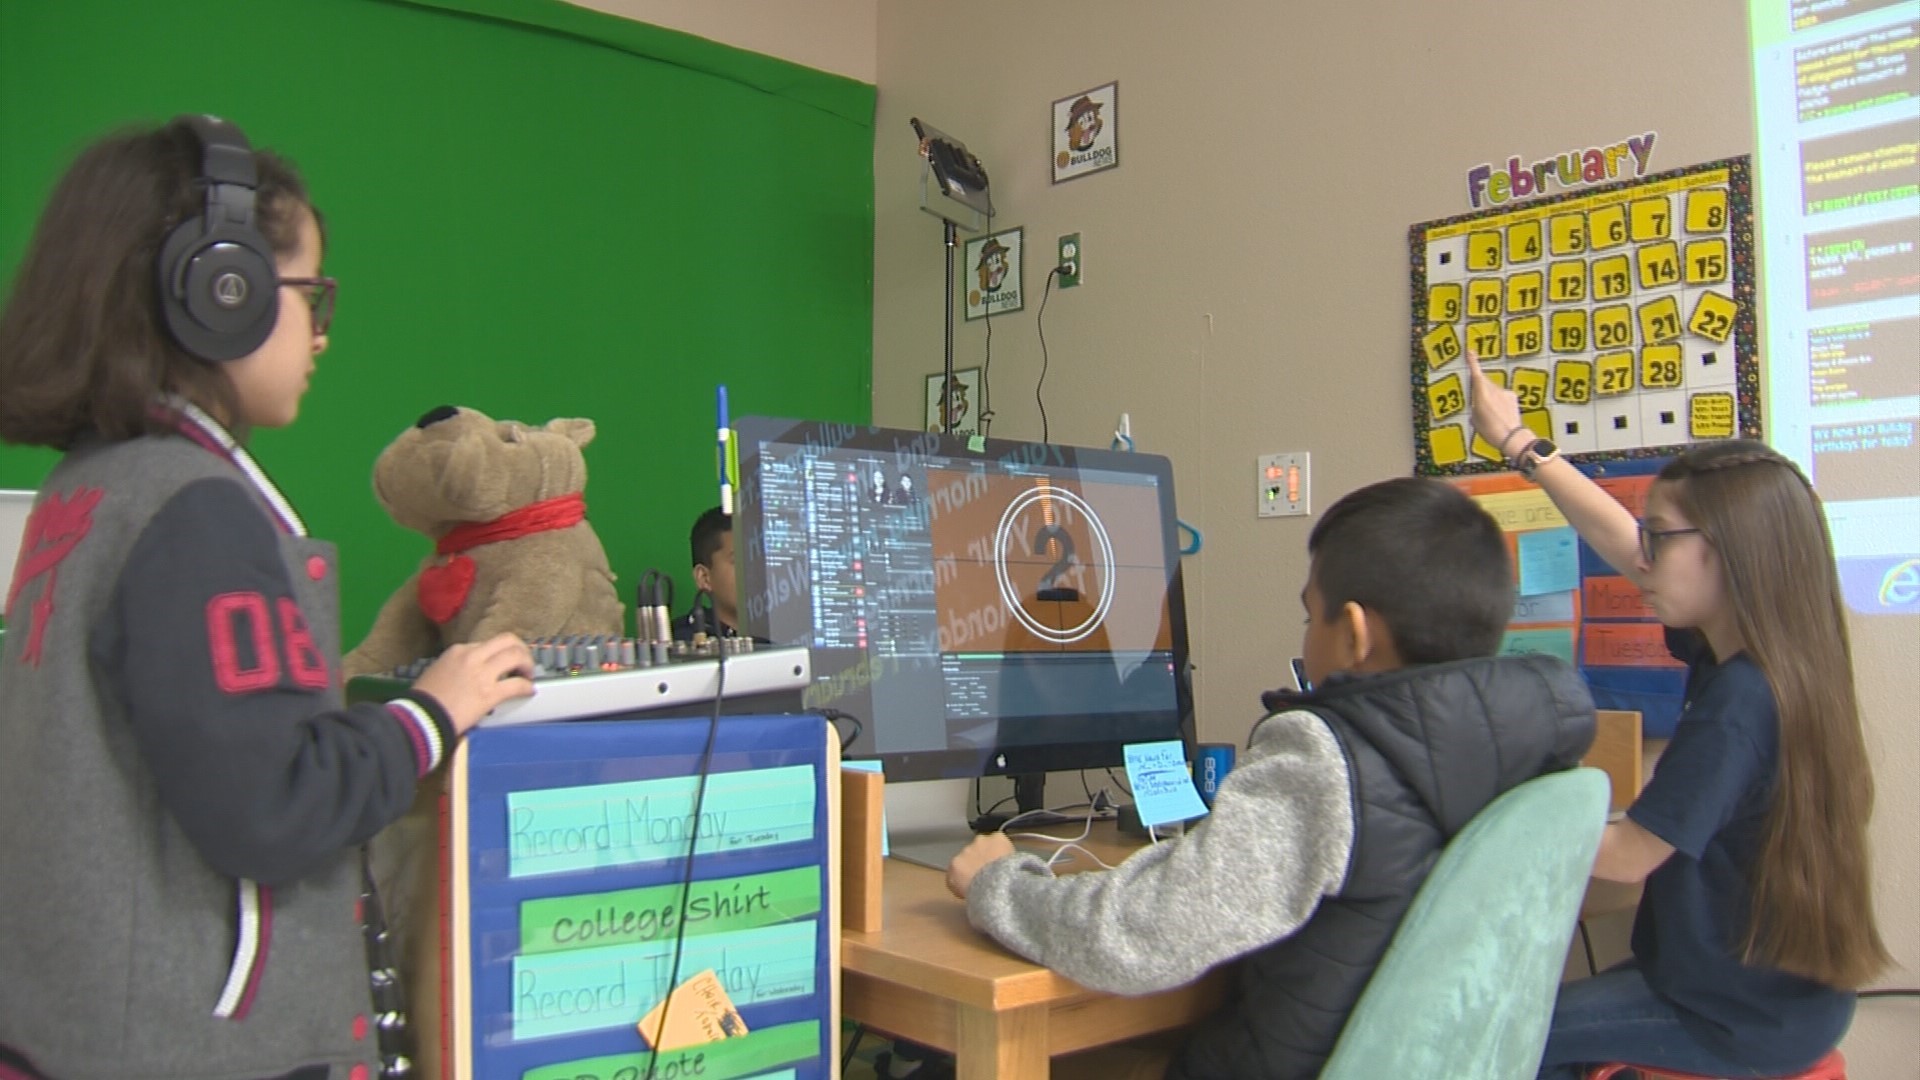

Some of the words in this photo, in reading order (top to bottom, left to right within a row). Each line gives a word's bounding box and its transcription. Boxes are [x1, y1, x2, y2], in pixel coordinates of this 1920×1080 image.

[1070, 146, 1112, 165] BULLDOG
[1468, 133, 1656, 208] February
[1486, 246, 1497, 267] 3
[1524, 235, 1537, 256] 4
[1569, 228, 1581, 249] 5
[1609, 220, 1623, 241] 6
[1651, 213, 1666, 236] 7
[1707, 205, 1722, 228] 8
[1445, 299, 1457, 320] 9
[1474, 292, 1498, 313] 10
[1518, 286, 1539, 308] 11
[1559, 275, 1582, 297] 12
[1602, 273, 1626, 295] 13
[1648, 258, 1675, 281] 14
[1696, 255, 1722, 280] 15
[1433, 339, 1456, 361] 16
[1474, 334, 1497, 355] 17
[1515, 331, 1538, 352] 18
[1559, 326, 1582, 348] 19
[1599, 322, 1628, 344] 20
[1652, 314, 1676, 338] 21
[1698, 309, 1729, 338] 22
[1437, 390, 1460, 413] 23
[1518, 385, 1542, 406] 25
[1560, 378, 1585, 399] 26
[1603, 368, 1629, 389] 27
[1650, 360, 1677, 382] 28
[1034, 525, 1080, 602] 2
[511, 799, 611, 860] Record
[626, 790, 727, 850] Monday
[552, 903, 675, 944] College
[684, 883, 772, 922] Shirt
[517, 960, 626, 1022] Record
